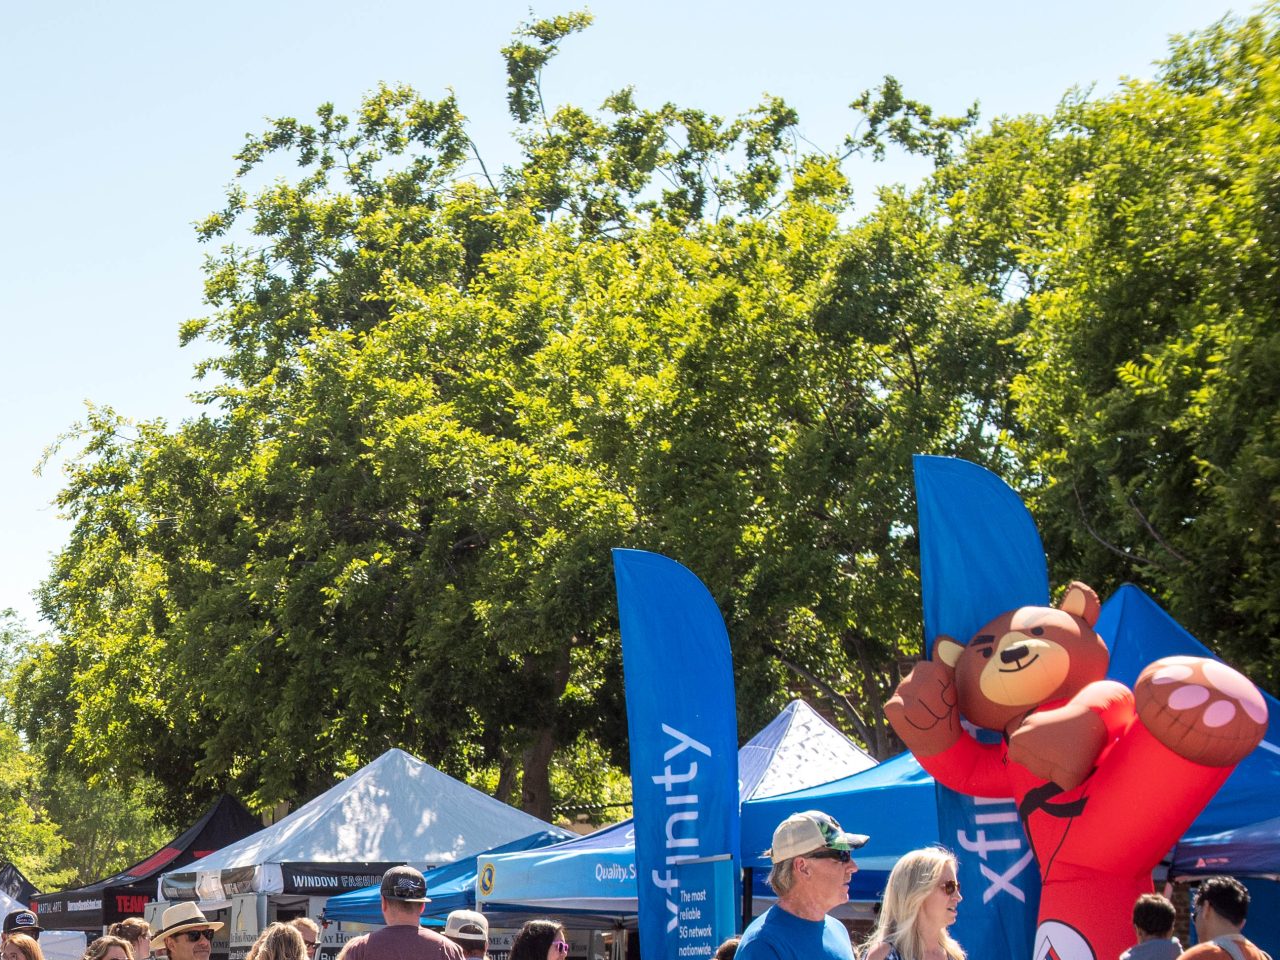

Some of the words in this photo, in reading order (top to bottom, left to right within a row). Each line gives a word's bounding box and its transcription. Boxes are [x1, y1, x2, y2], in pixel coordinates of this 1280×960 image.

[595, 863, 629, 882] Quality.
[293, 875, 338, 887] WINDOW
[341, 874, 382, 887] FASHIO
[681, 890, 691, 903] The
[691, 889, 706, 901] most
[116, 896, 149, 913] TEAM
[680, 907, 701, 920] reliable
[680, 926, 688, 938] 5G
[689, 924, 712, 937] network
[679, 942, 712, 957] nationwide
